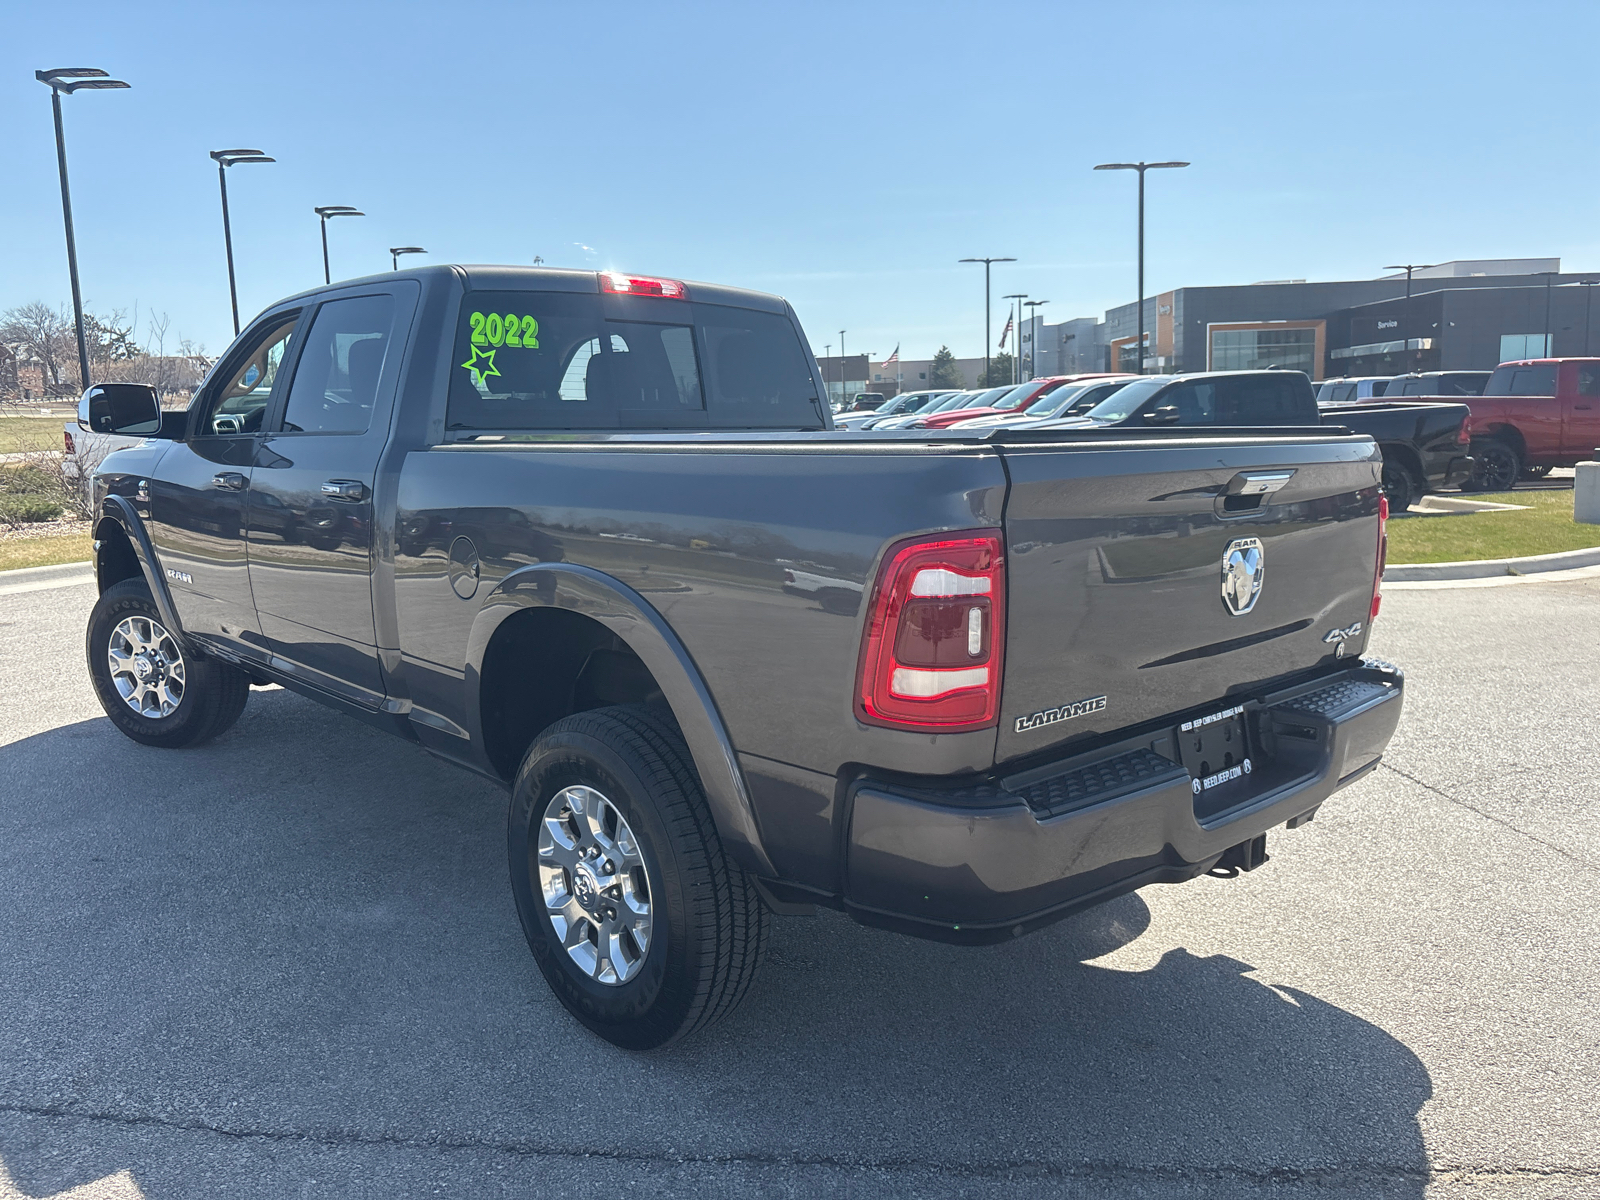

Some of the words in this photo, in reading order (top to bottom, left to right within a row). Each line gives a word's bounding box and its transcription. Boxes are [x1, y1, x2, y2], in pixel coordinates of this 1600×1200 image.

[469, 311, 539, 349] 2022
[1377, 320, 1398, 330] Service
[1234, 539, 1257, 548] RAM
[167, 568, 193, 584] RAM
[1014, 695, 1107, 733] LARAMIE
[1181, 721, 1193, 732] REED
[1193, 718, 1202, 728] JEEP
[1202, 712, 1222, 725] CHRYSLER
[1222, 707, 1234, 719] DODGE
[1203, 766, 1242, 790] REEDJEEP.COM
